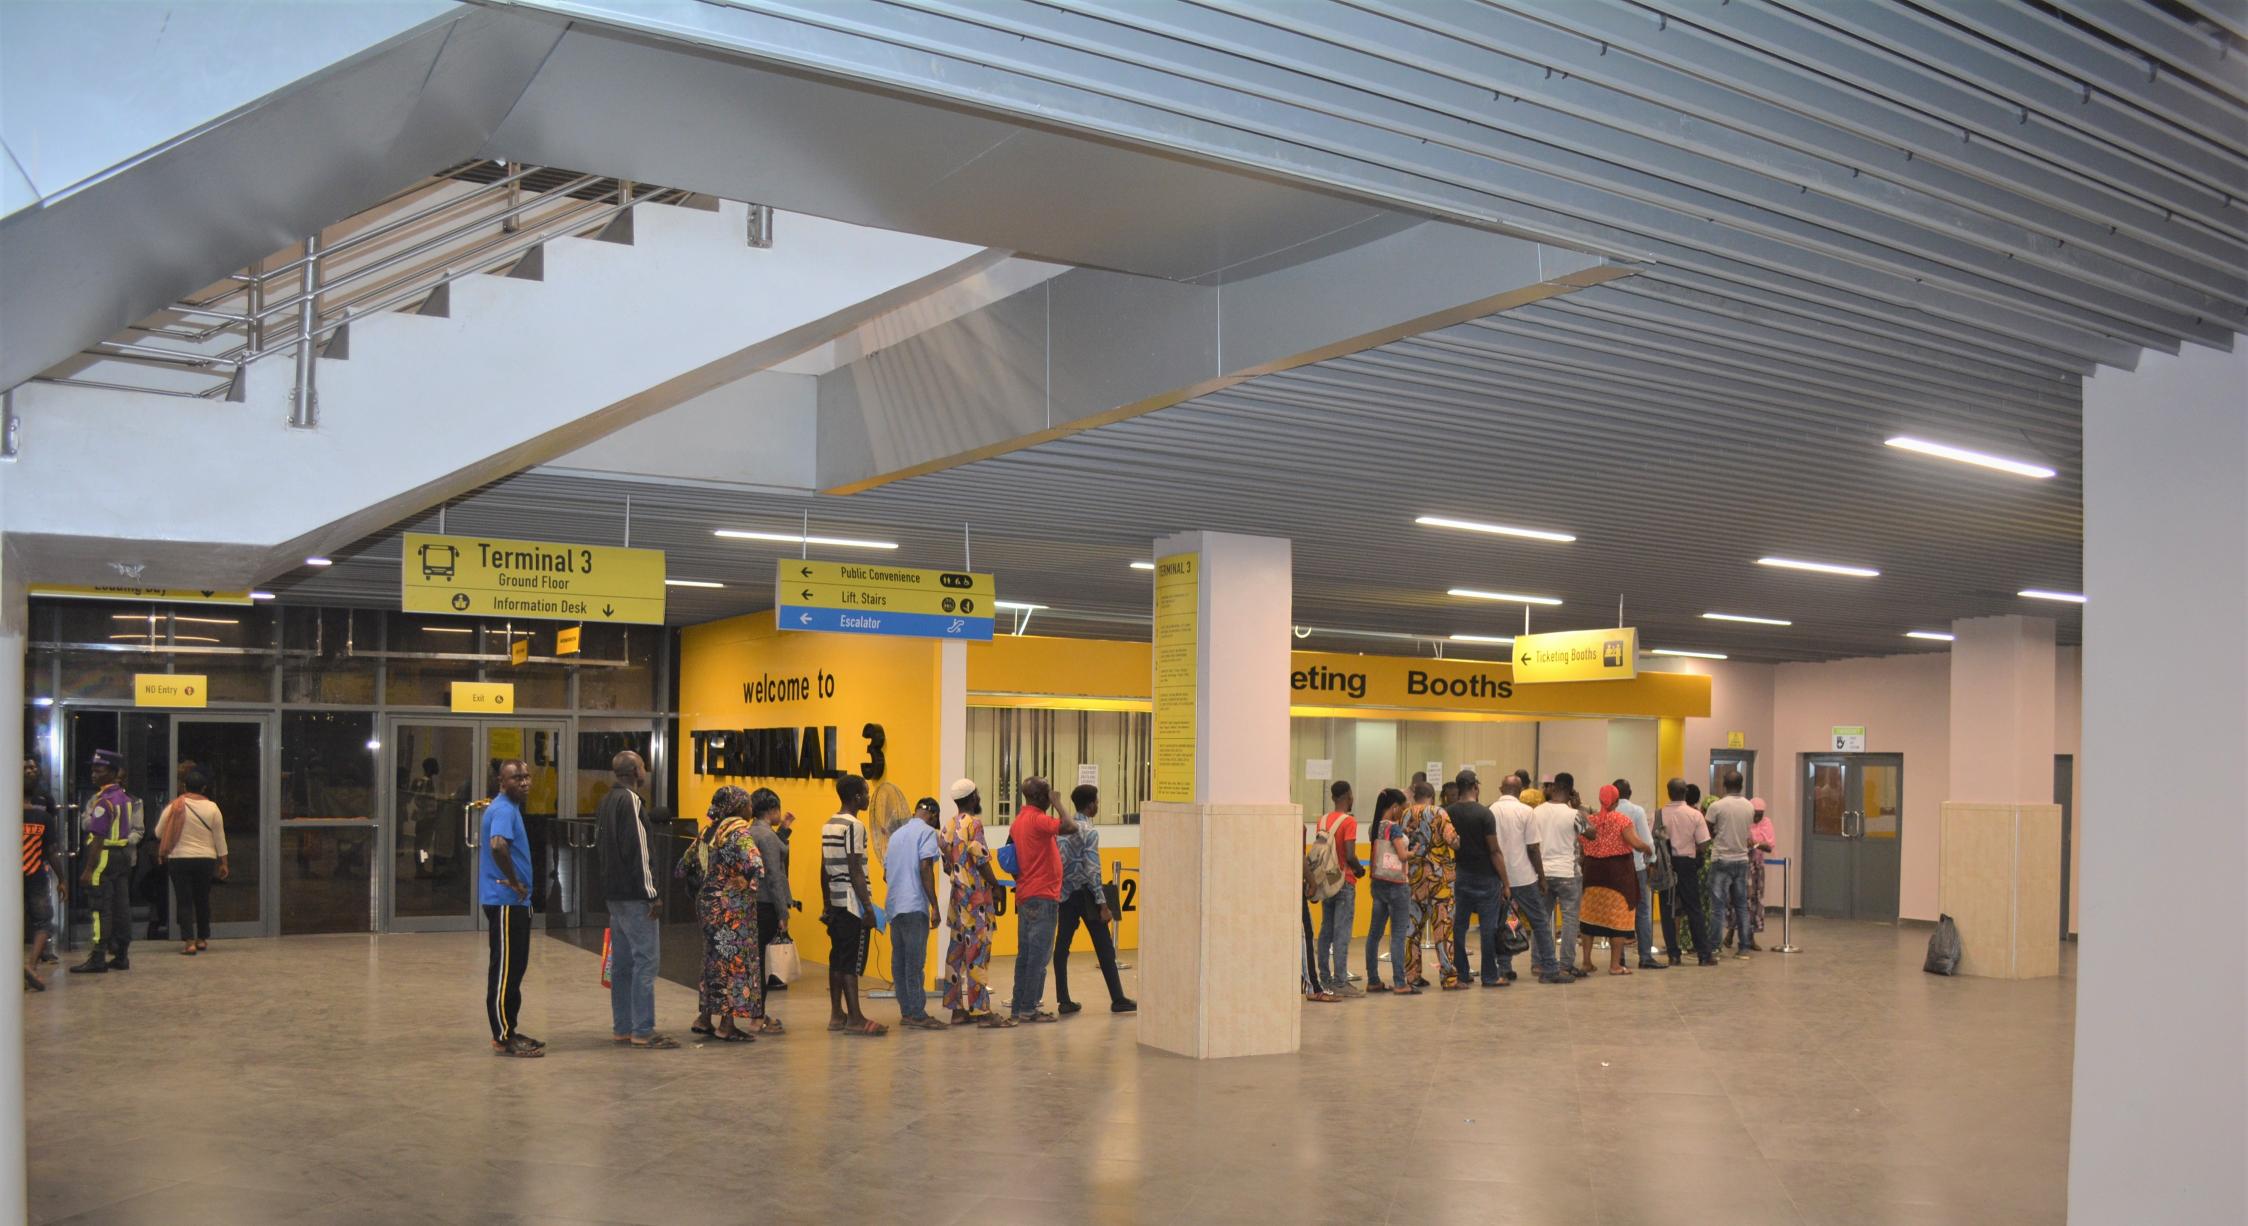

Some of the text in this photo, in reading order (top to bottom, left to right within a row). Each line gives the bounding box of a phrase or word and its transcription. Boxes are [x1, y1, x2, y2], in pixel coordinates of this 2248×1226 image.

[478, 543, 592, 574] Terminal 3
[841, 566, 921, 584] Public Convenience
[1186, 561, 1191, 574] 3
[499, 573, 570, 590] Ground Floor
[493, 597, 587, 614] Information Desk
[861, 592, 887, 606] Stairs
[840, 615, 881, 629] Escalator
[1536, 648, 1597, 665] Ticketing Booths
[158, 685, 178, 696] Entry
[743, 668, 835, 704] welcome to
[1291, 665, 1513, 699] eting Booths
[472, 694, 485, 702] Exit
[690, 723, 886, 780] TERMINAL 3
